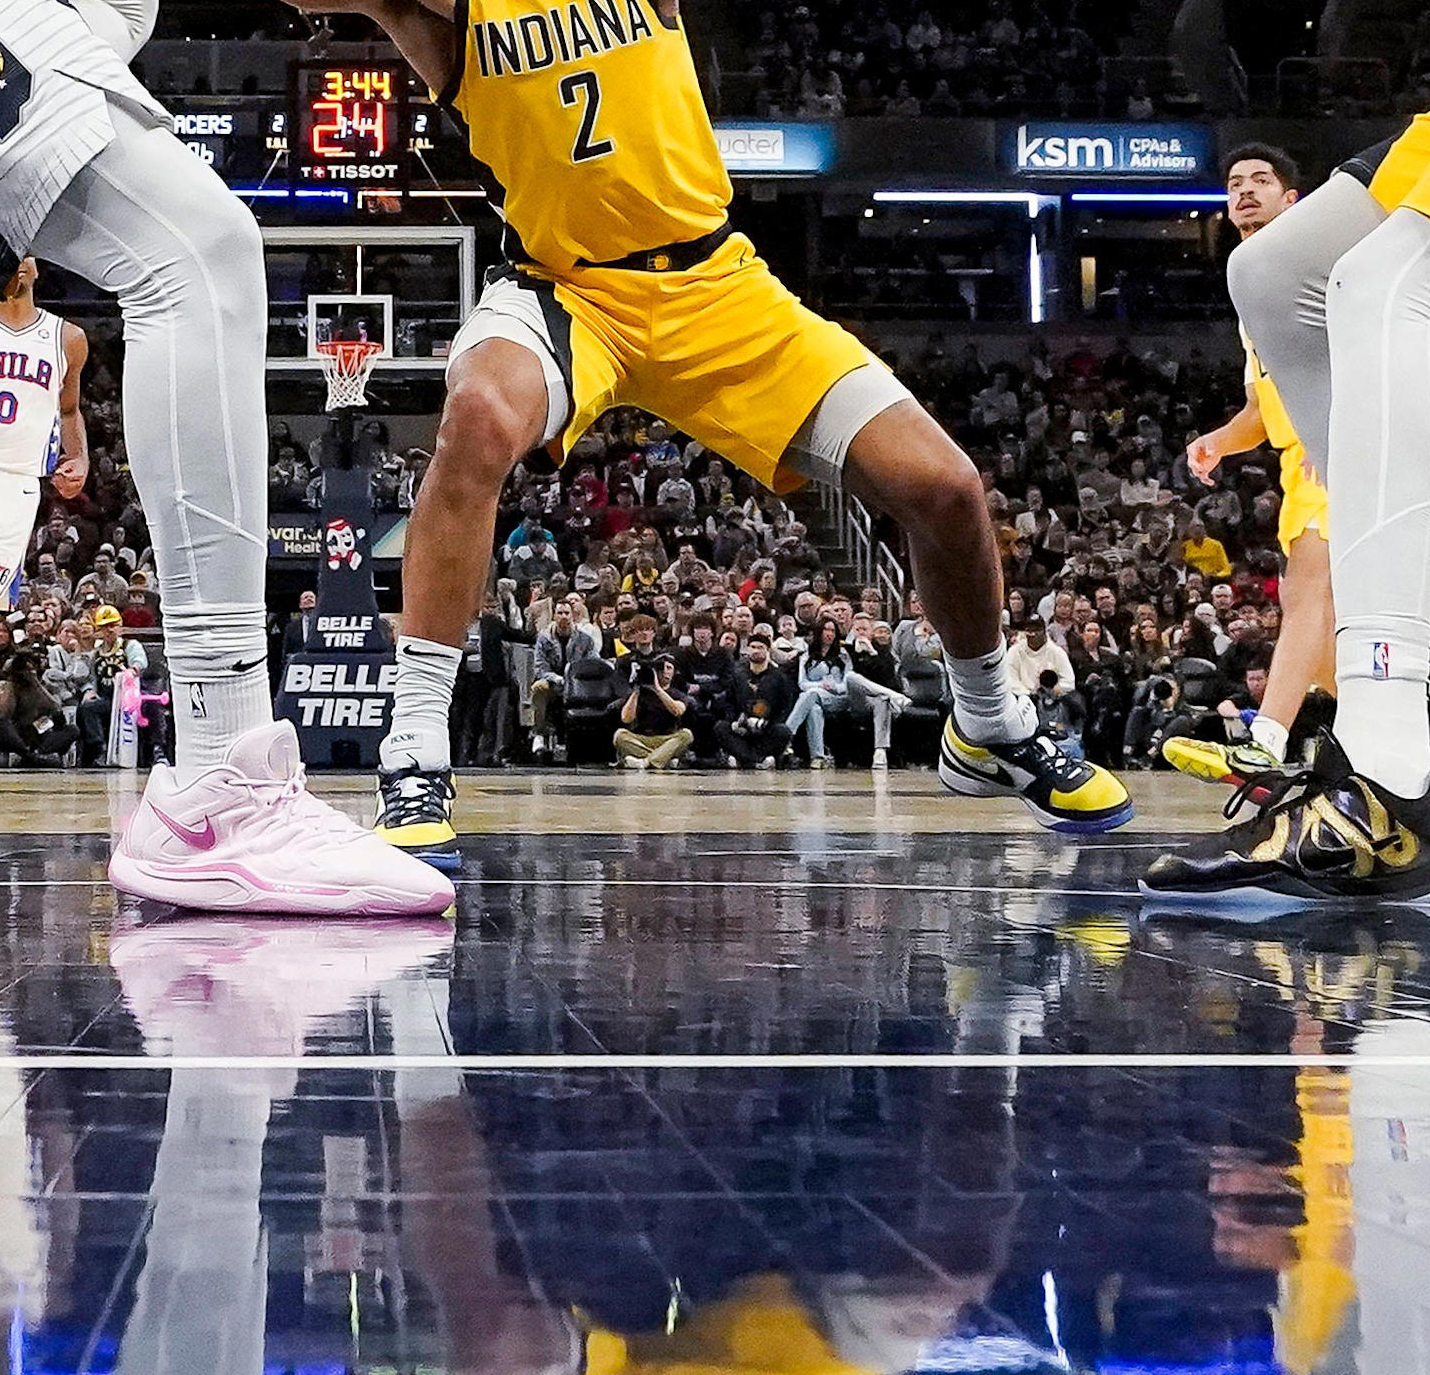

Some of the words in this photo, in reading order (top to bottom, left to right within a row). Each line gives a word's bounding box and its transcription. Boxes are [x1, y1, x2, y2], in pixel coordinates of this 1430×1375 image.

[321, 71, 391, 101] 3:44
[173, 114, 233, 135] ACERS
[272, 114, 285, 133] 2
[414, 114, 427, 133] 2
[558, 69, 615, 164] 2
[312, 101, 385, 156] 24
[1017, 125, 1114, 168] ksm
[1128, 138, 1168, 153] CPAs
[1169, 138, 1182, 153] &
[1128, 152, 1196, 168] Advisors
[327, 164, 398, 179] TISSOT
[284, 542, 321, 554] Healt
[317, 616, 373, 631] BELLE
[323, 632, 366, 648] TIRE
[284, 663, 399, 694] BELLE
[298, 697, 386, 727] TIRE
